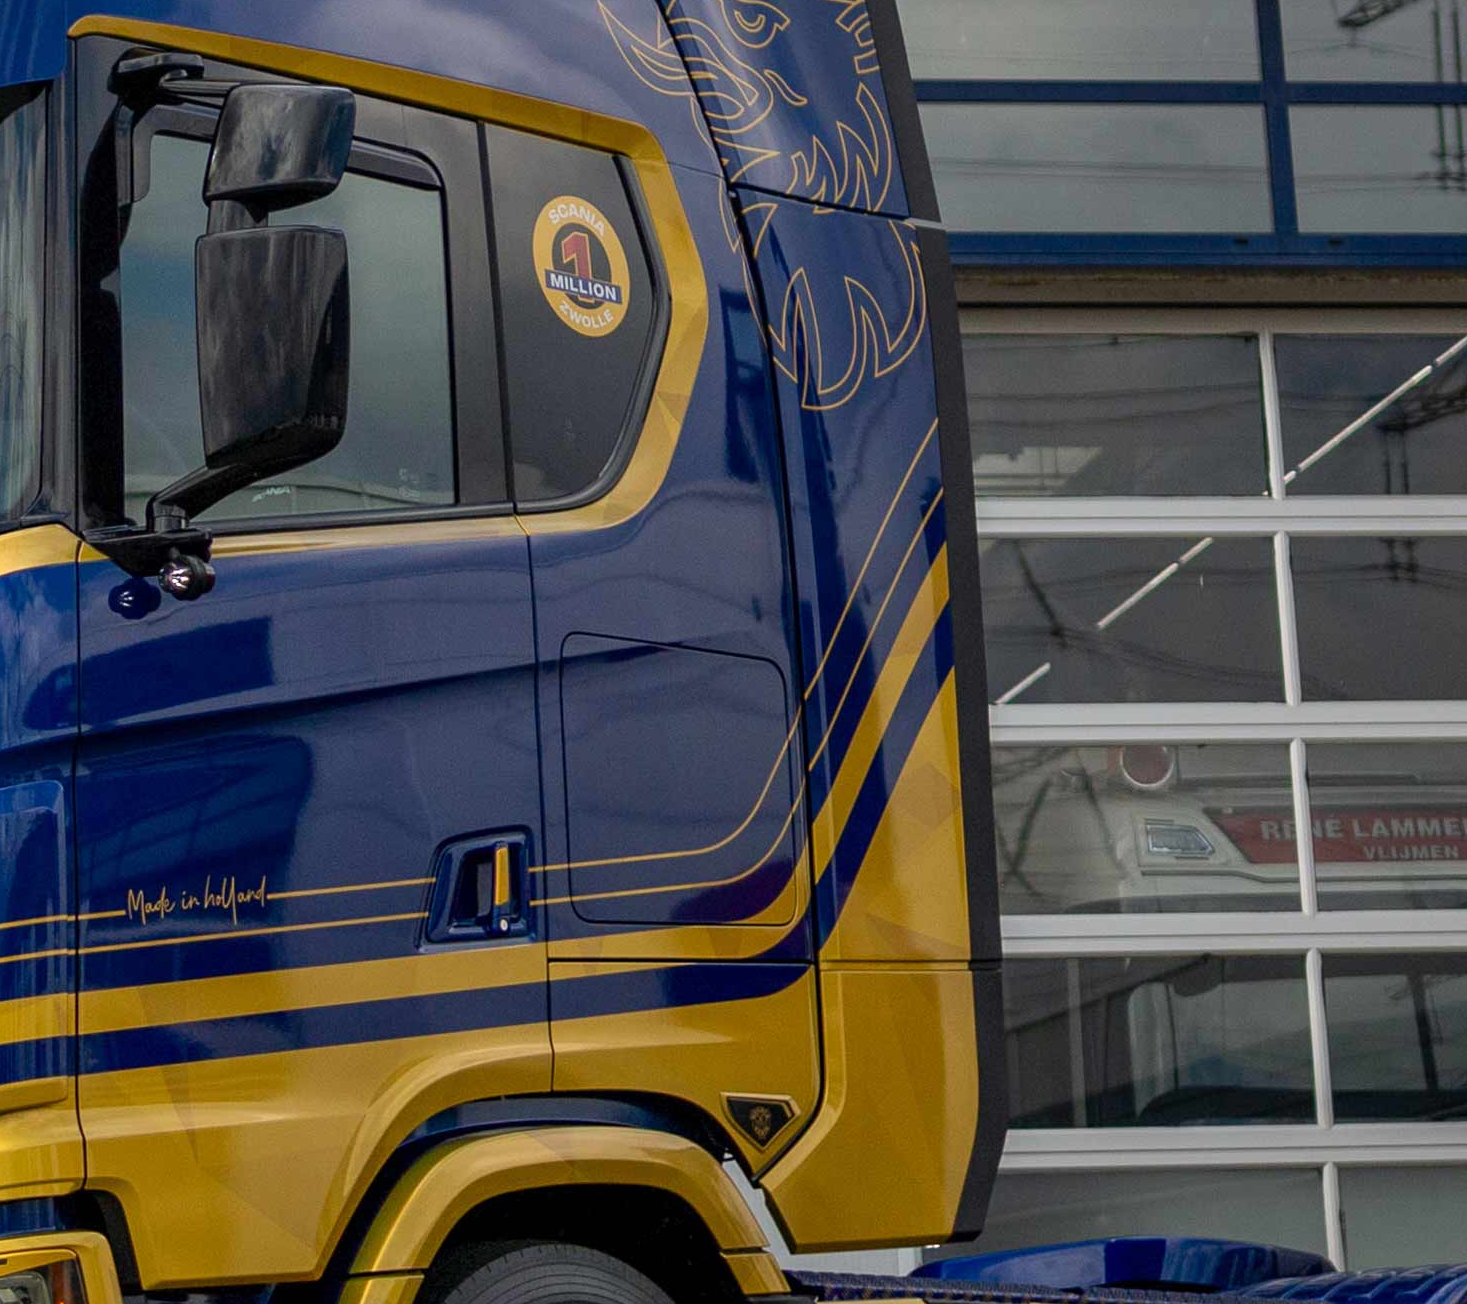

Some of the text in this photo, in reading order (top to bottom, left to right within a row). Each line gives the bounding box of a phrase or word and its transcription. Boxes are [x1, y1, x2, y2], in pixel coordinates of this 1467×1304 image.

[548, 203, 605, 237] SCANIA
[562, 231, 595, 302] 1
[550, 273, 617, 301] MILLION
[559, 300, 614, 329] ZWOLLE
[1363, 845, 1460, 860] VLIJMEN
[127, 886, 175, 925] Made
[181, 891, 200, 910] in
